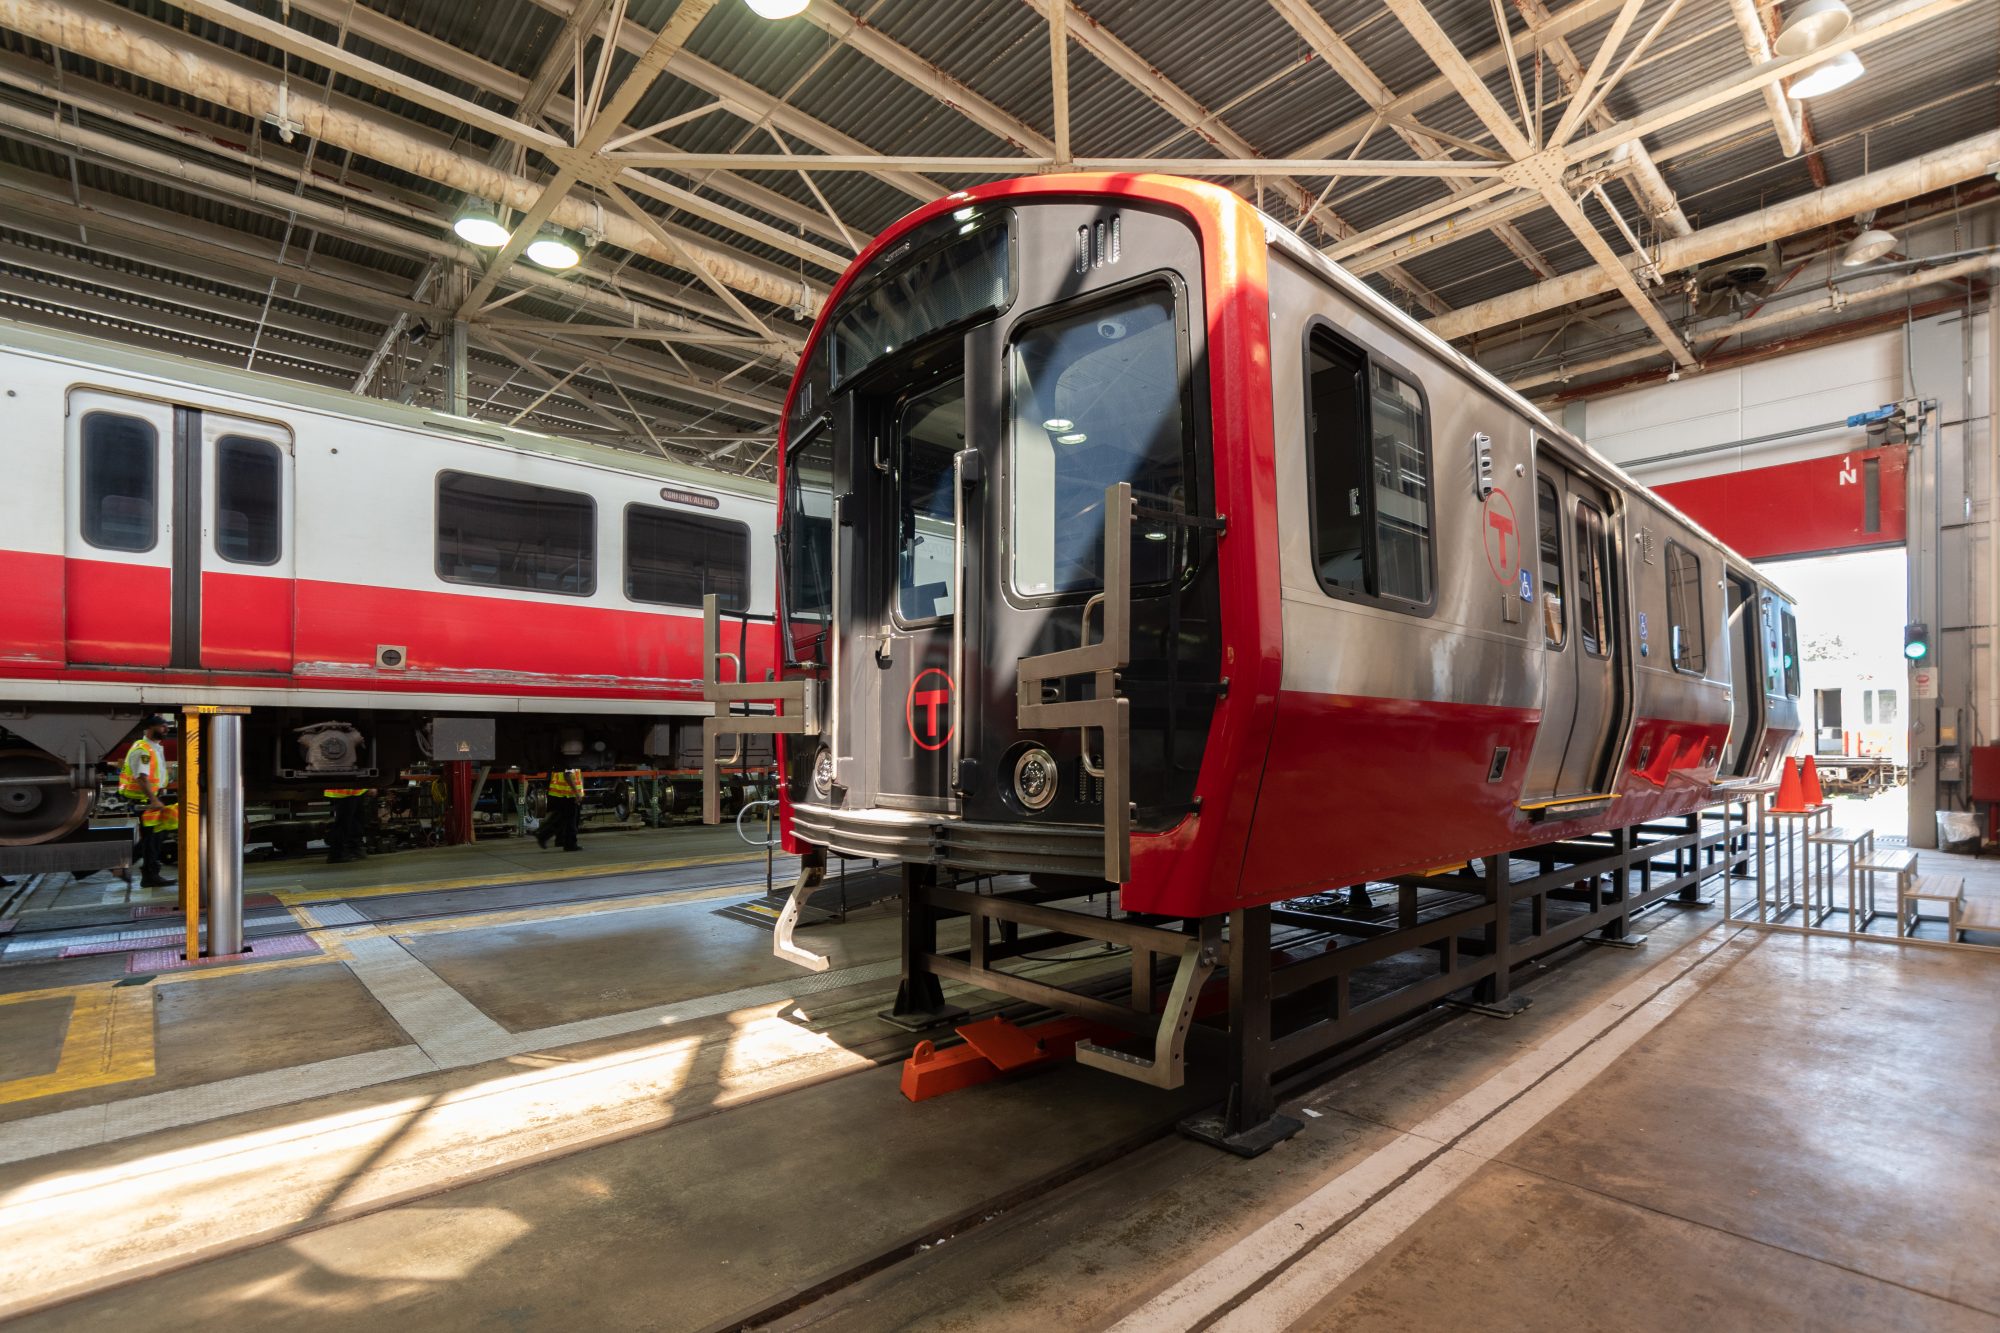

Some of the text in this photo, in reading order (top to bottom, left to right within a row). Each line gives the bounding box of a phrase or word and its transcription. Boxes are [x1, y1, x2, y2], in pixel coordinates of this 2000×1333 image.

[1840, 469, 1857, 485] N
[1843, 456, 1849, 471] 1
[1489, 510, 1512, 570] T
[915, 689, 948, 736] T
